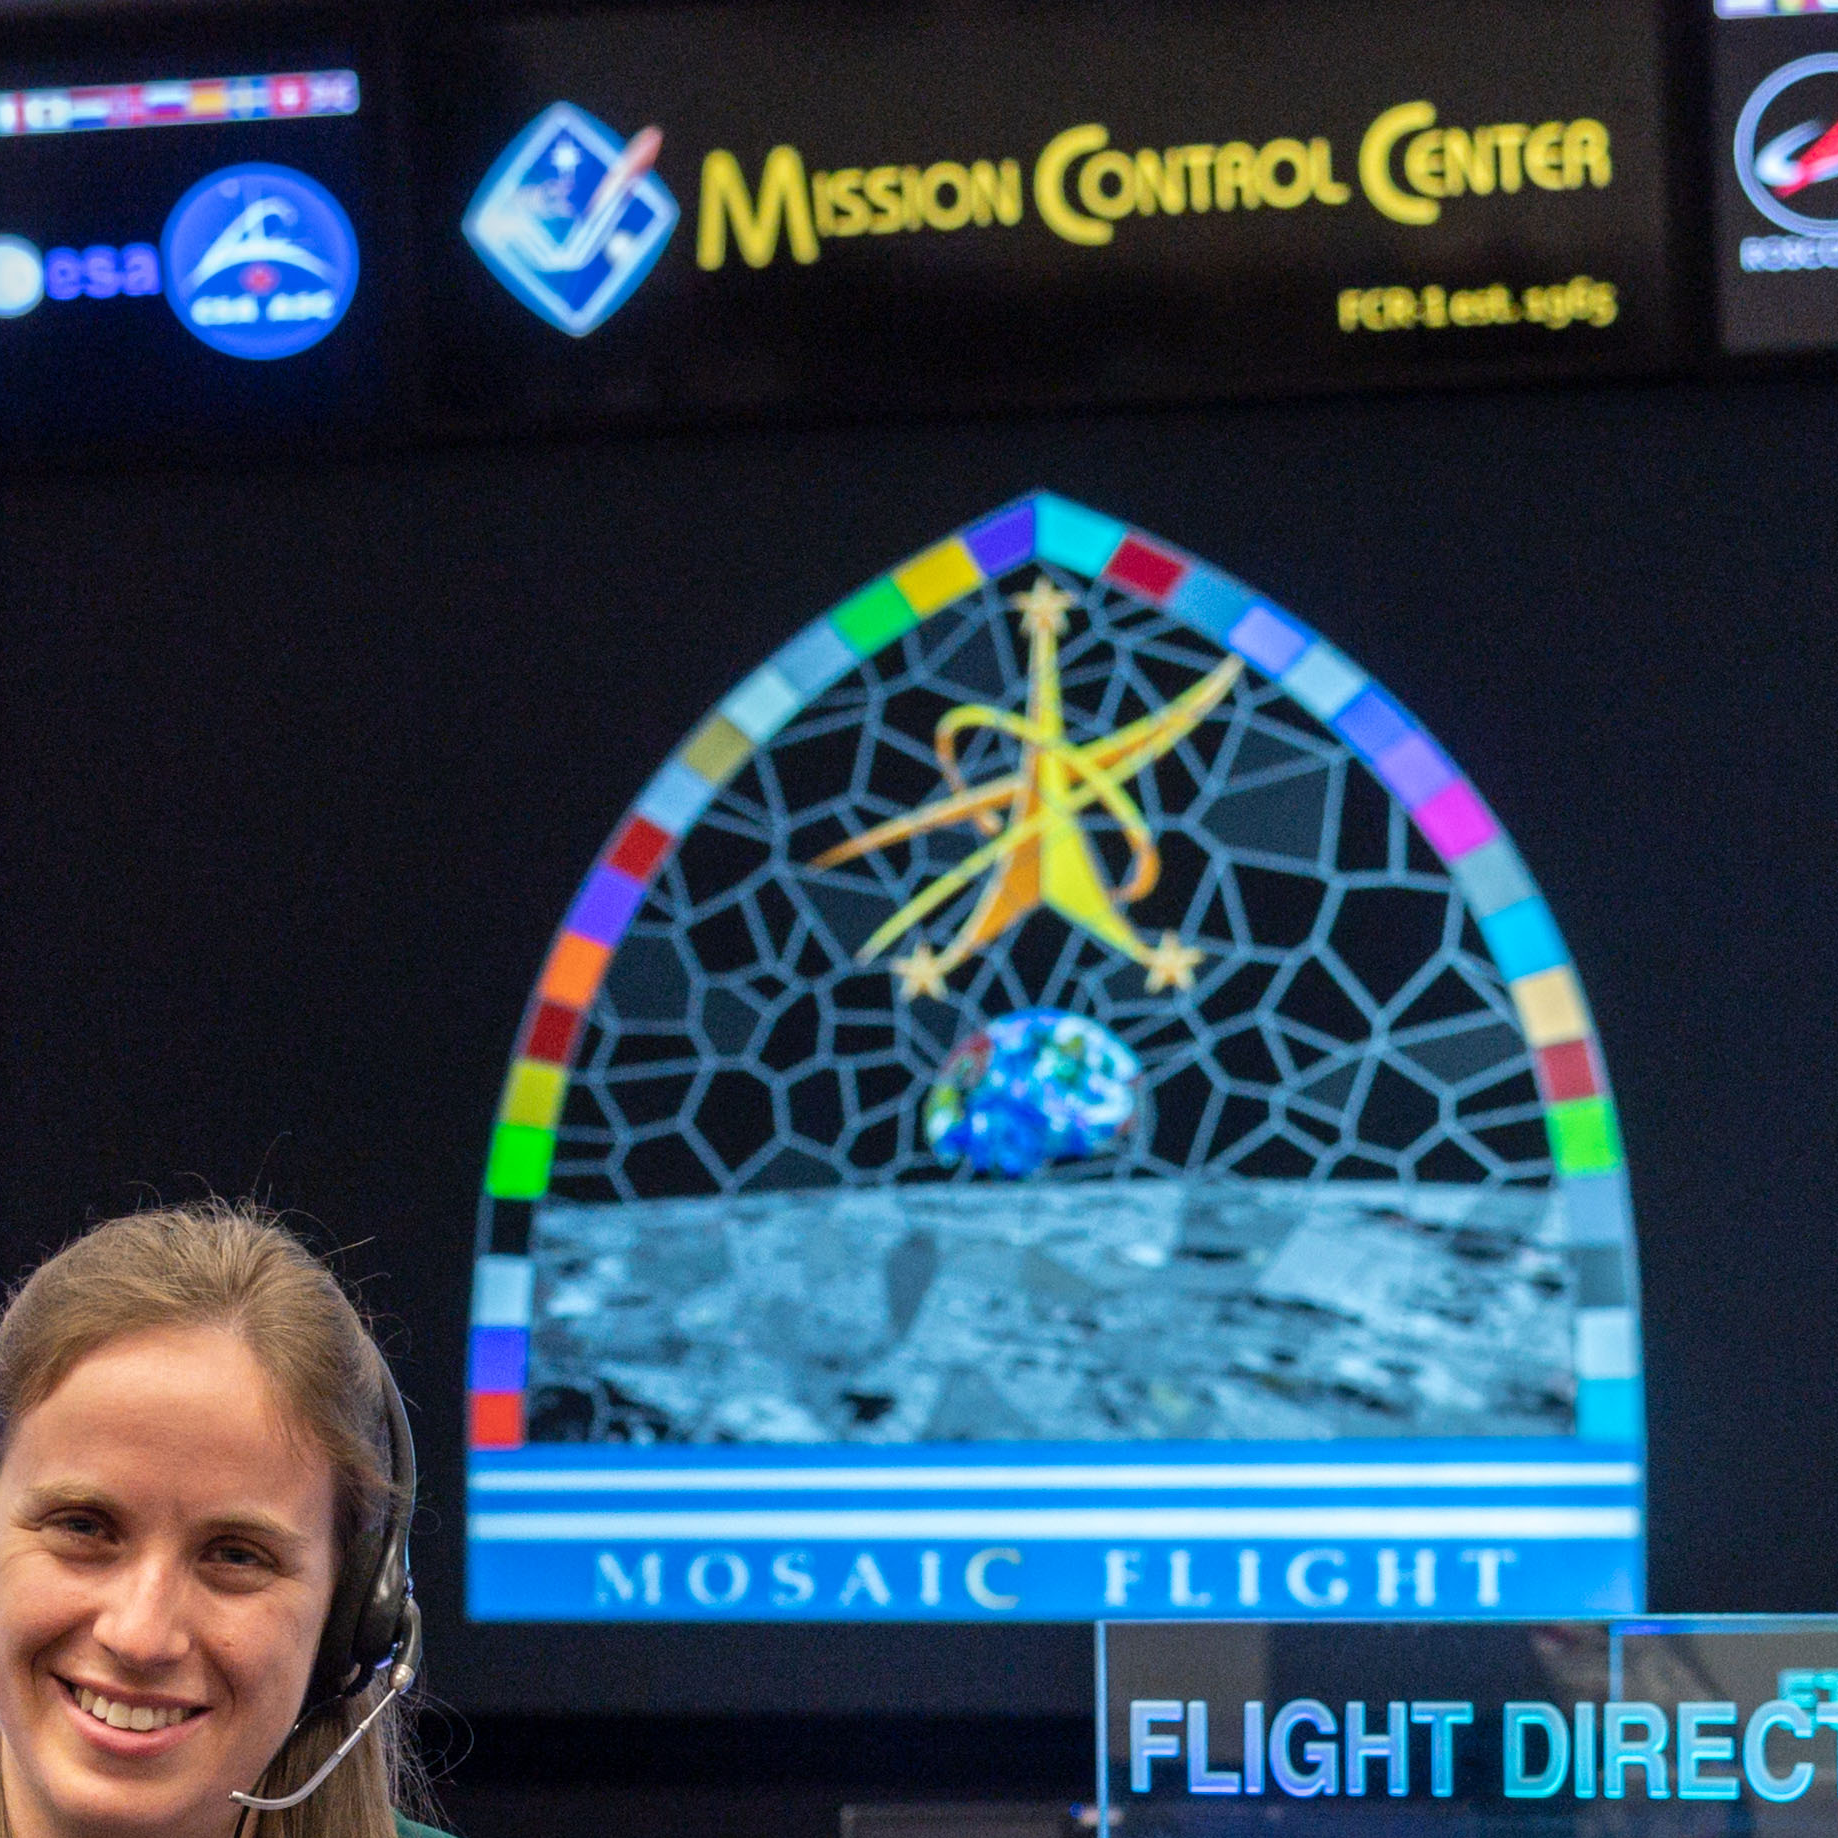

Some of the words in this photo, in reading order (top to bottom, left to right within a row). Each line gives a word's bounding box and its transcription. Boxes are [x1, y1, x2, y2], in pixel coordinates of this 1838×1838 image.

[45, 242, 160, 300] esa
[594, 1546, 1026, 1611] MOSAIC
[1103, 1544, 1518, 1609] FLIGHT
[1131, 1698, 1473, 1799] FLIGHT
